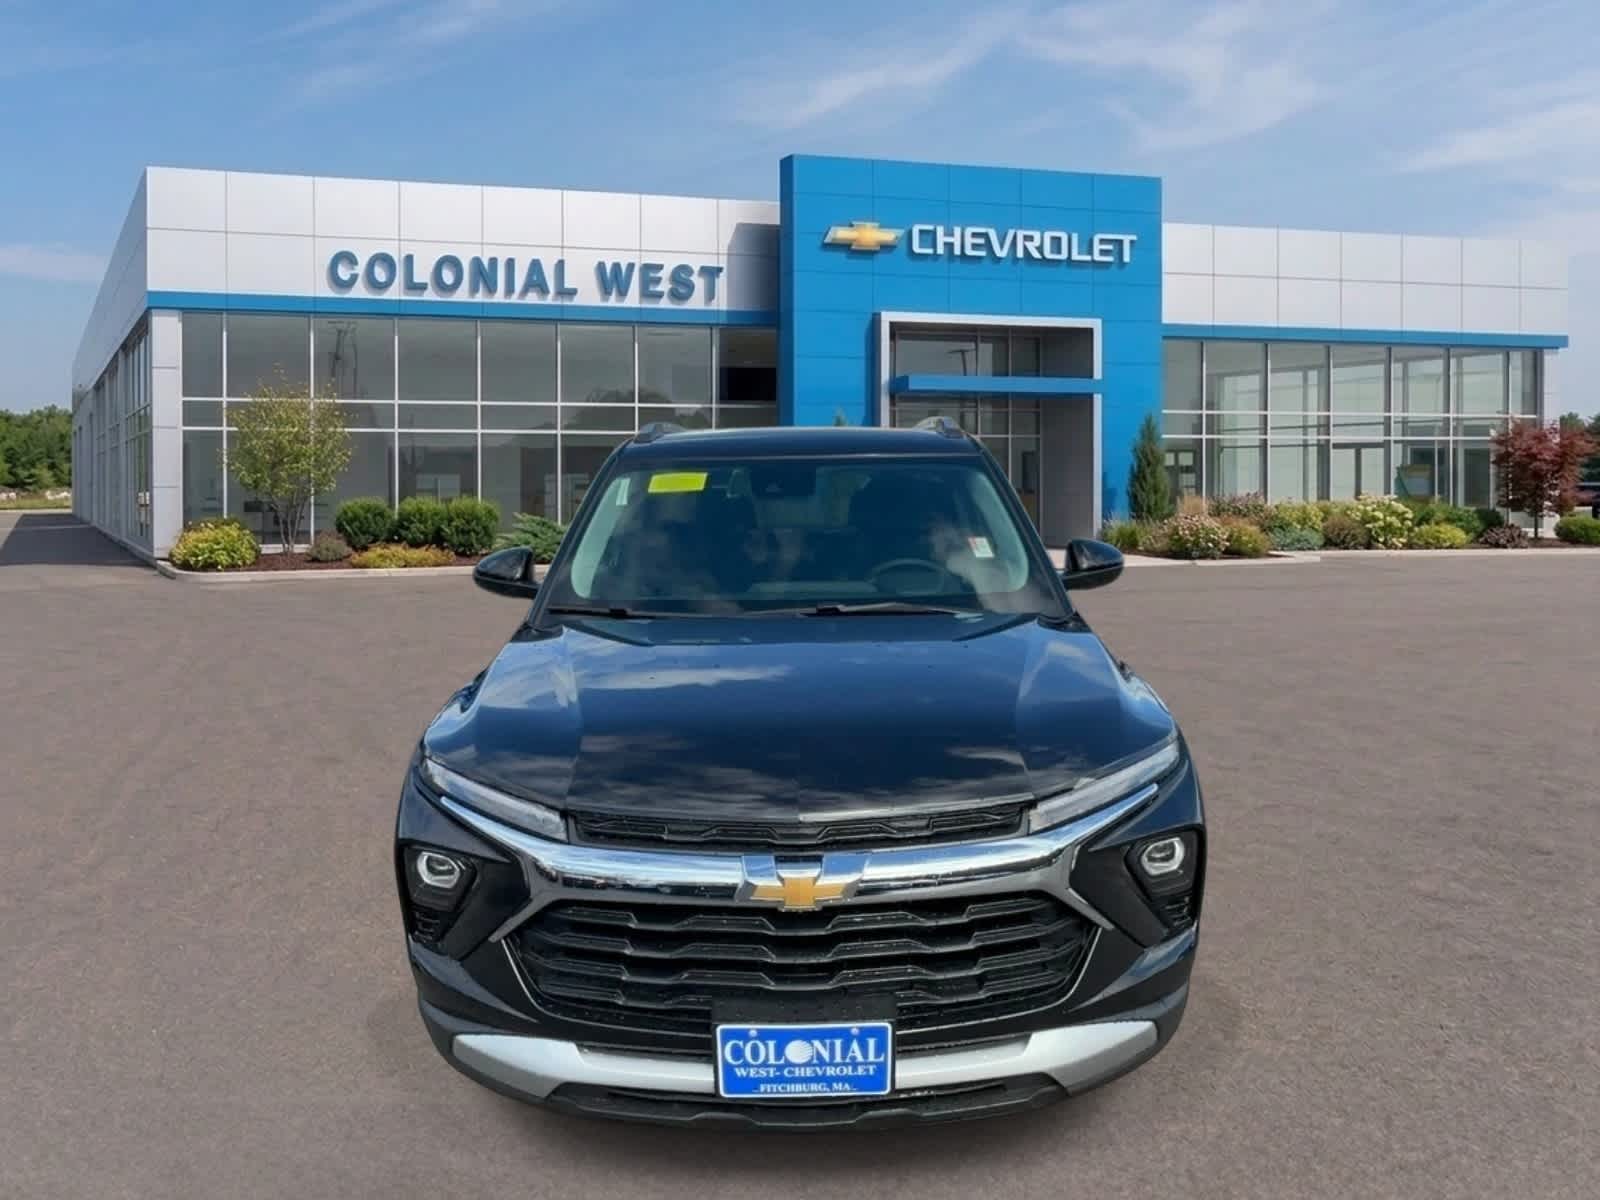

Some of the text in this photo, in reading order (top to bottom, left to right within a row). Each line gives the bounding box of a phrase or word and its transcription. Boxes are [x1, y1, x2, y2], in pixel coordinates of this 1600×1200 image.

[911, 223, 1137, 263] CHEVROLET
[327, 249, 723, 303] COLONIAL WEST
[724, 1037, 885, 1065] COLONIAL
[783, 1065, 877, 1077] CHEVROLET
